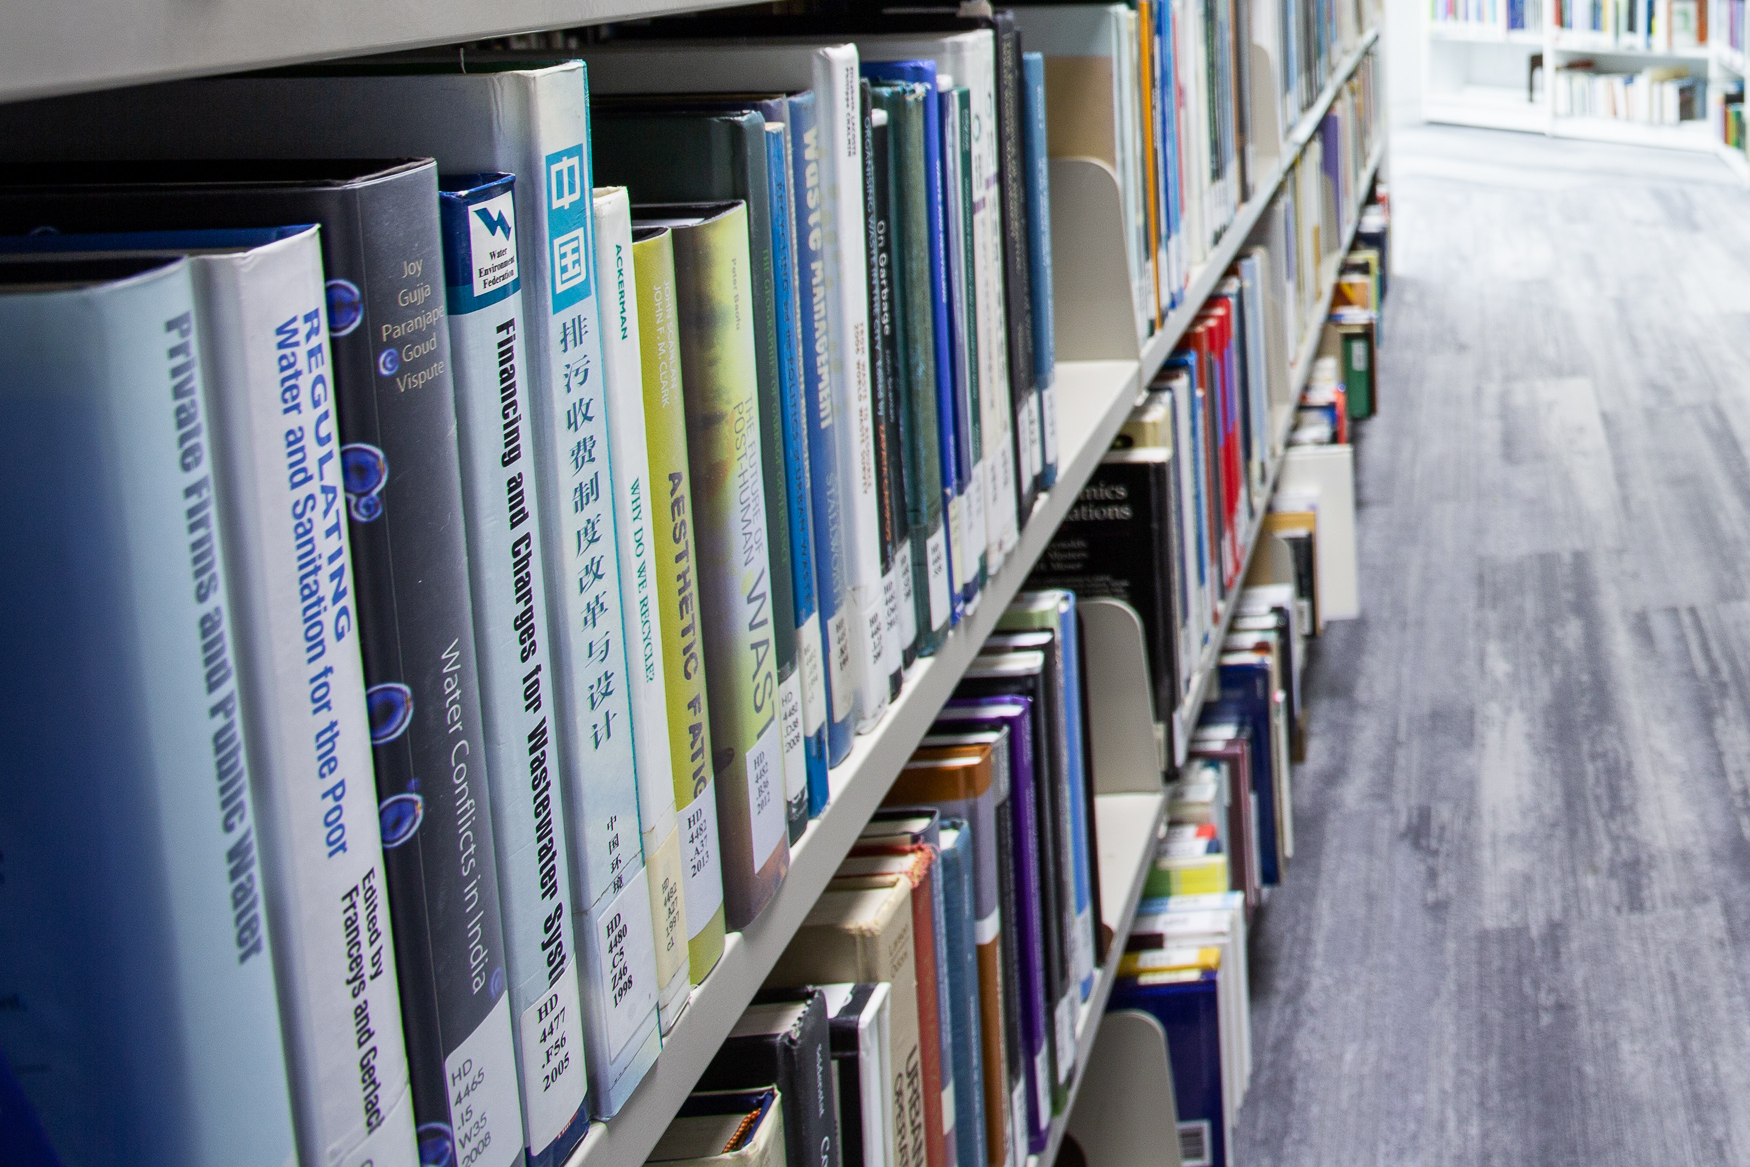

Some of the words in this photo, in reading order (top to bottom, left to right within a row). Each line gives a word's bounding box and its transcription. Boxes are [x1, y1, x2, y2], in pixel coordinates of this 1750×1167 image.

[489, 247, 508, 260] Water
[550, 156, 587, 295] 中国
[398, 283, 431, 307] Gujja
[402, 259, 423, 278] Joy
[478, 255, 515, 278] Environment
[483, 269, 514, 289] Federation
[615, 244, 628, 340] ACKERMAN
[382, 305, 445, 342] Paranjape
[402, 332, 437, 362] Goud
[164, 311, 204, 473] Private
[275, 315, 303, 415] Water
[396, 361, 445, 392] Vispute
[496, 318, 522, 468] Financing
[285, 426, 314, 491] and
[304, 307, 350, 643] REGULATING
[506, 472, 529, 530] and
[630, 477, 643, 523] WHY
[183, 475, 219, 605] Firms
[634, 525, 645, 557] DO
[734, 401, 755, 567] POST-HUMAN
[747, 567, 775, 742] WAST
[292, 493, 327, 665] Sanitation
[510, 532, 537, 664] Charges
[637, 559, 647, 594] WE
[200, 606, 234, 696] and
[639, 593, 655, 684] RECYCLE?
[668, 471, 700, 681] AESTHETIC
[687, 693, 707, 799] FATIG
[309, 666, 334, 715] for
[440, 638, 464, 734] Water
[522, 664, 542, 714] for
[209, 690, 247, 834] Public
[315, 720, 340, 779] the
[321, 778, 347, 859] Poor
[451, 740, 479, 877] Conflicts
[527, 715, 558, 900] Wastewater
[227, 826, 263, 965] Water
[362, 867, 381, 948] Edited
[465, 874, 481, 905] in
[341, 885, 367, 999] Franceys
[369, 945, 384, 981] by
[467, 911, 488, 995] India
[353, 1000, 375, 1049] and
[537, 994, 558, 1024] HD
[540, 1006, 566, 1044] 4477
[541, 1031, 567, 1069] .F56
[543, 1051, 570, 1092] 2005
